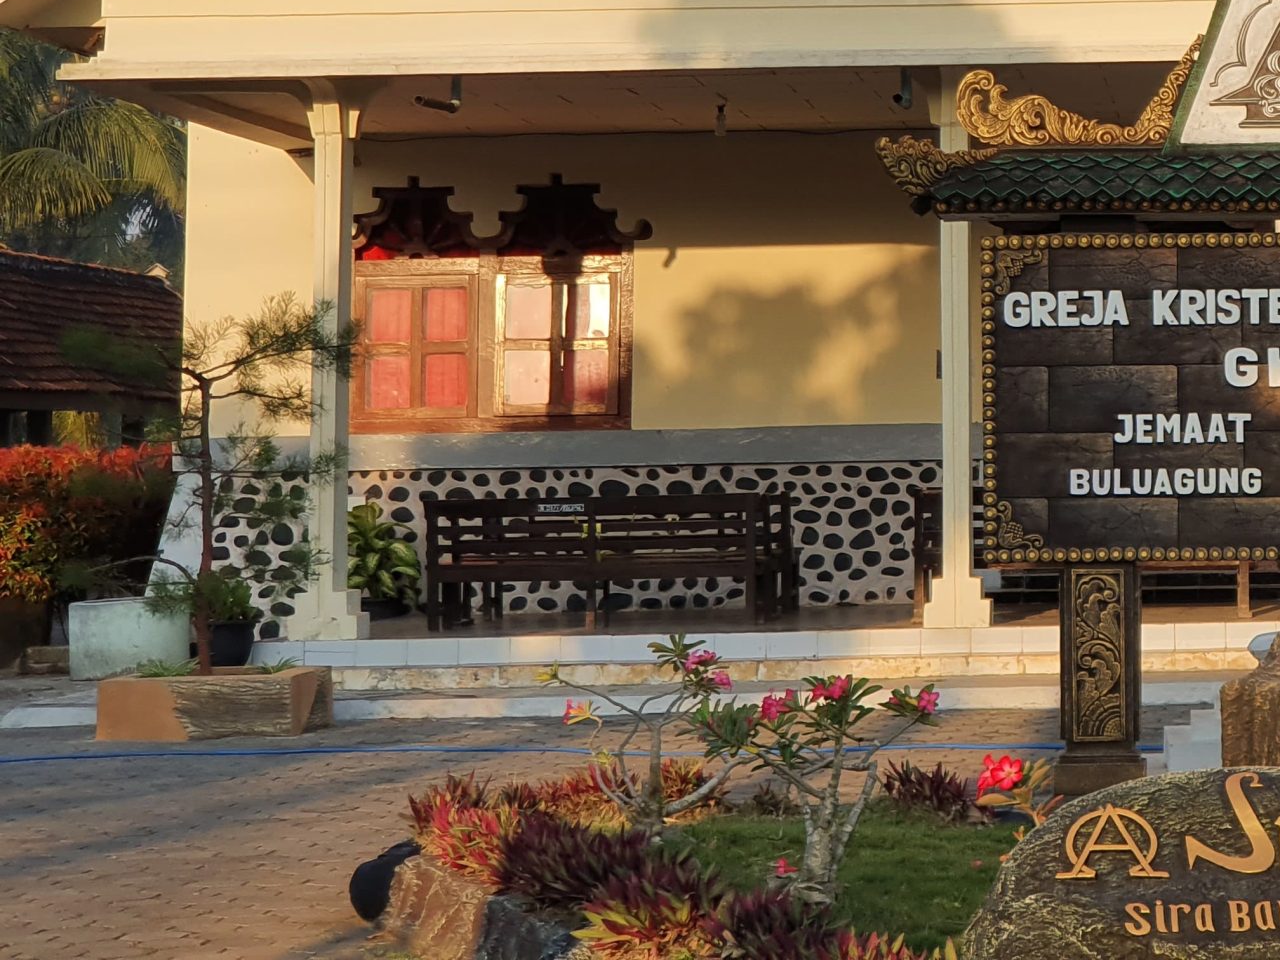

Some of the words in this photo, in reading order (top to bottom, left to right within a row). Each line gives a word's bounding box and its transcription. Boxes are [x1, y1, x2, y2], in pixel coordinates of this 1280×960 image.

[1002, 289, 1130, 328] GREJA
[1113, 411, 1253, 444] JEMAAT
[1068, 466, 1263, 496] BULUAGUNG
